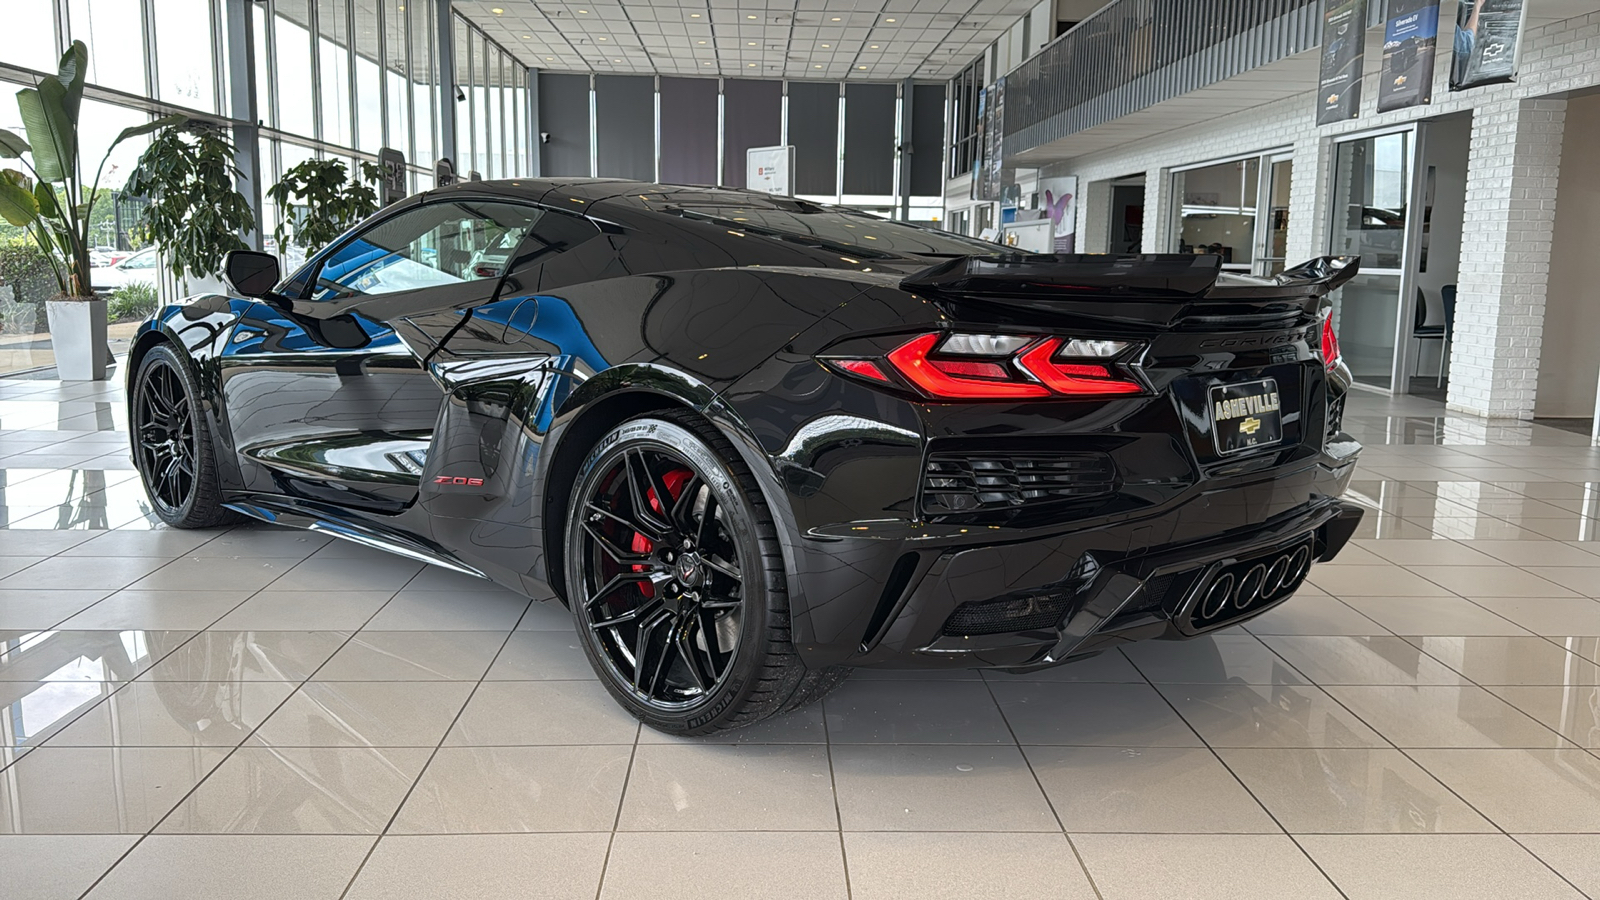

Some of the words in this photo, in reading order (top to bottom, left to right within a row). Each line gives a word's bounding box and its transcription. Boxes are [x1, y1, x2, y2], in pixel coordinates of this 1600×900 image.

[1200, 330, 1315, 348] CORVETTE
[1215, 392, 1279, 421] ASHEVILLE
[582, 431, 619, 474] MICHELIN
[1246, 437, 1258, 446] N.C.
[433, 475, 484, 487] Z06
[688, 692, 733, 728] MICHELIN
